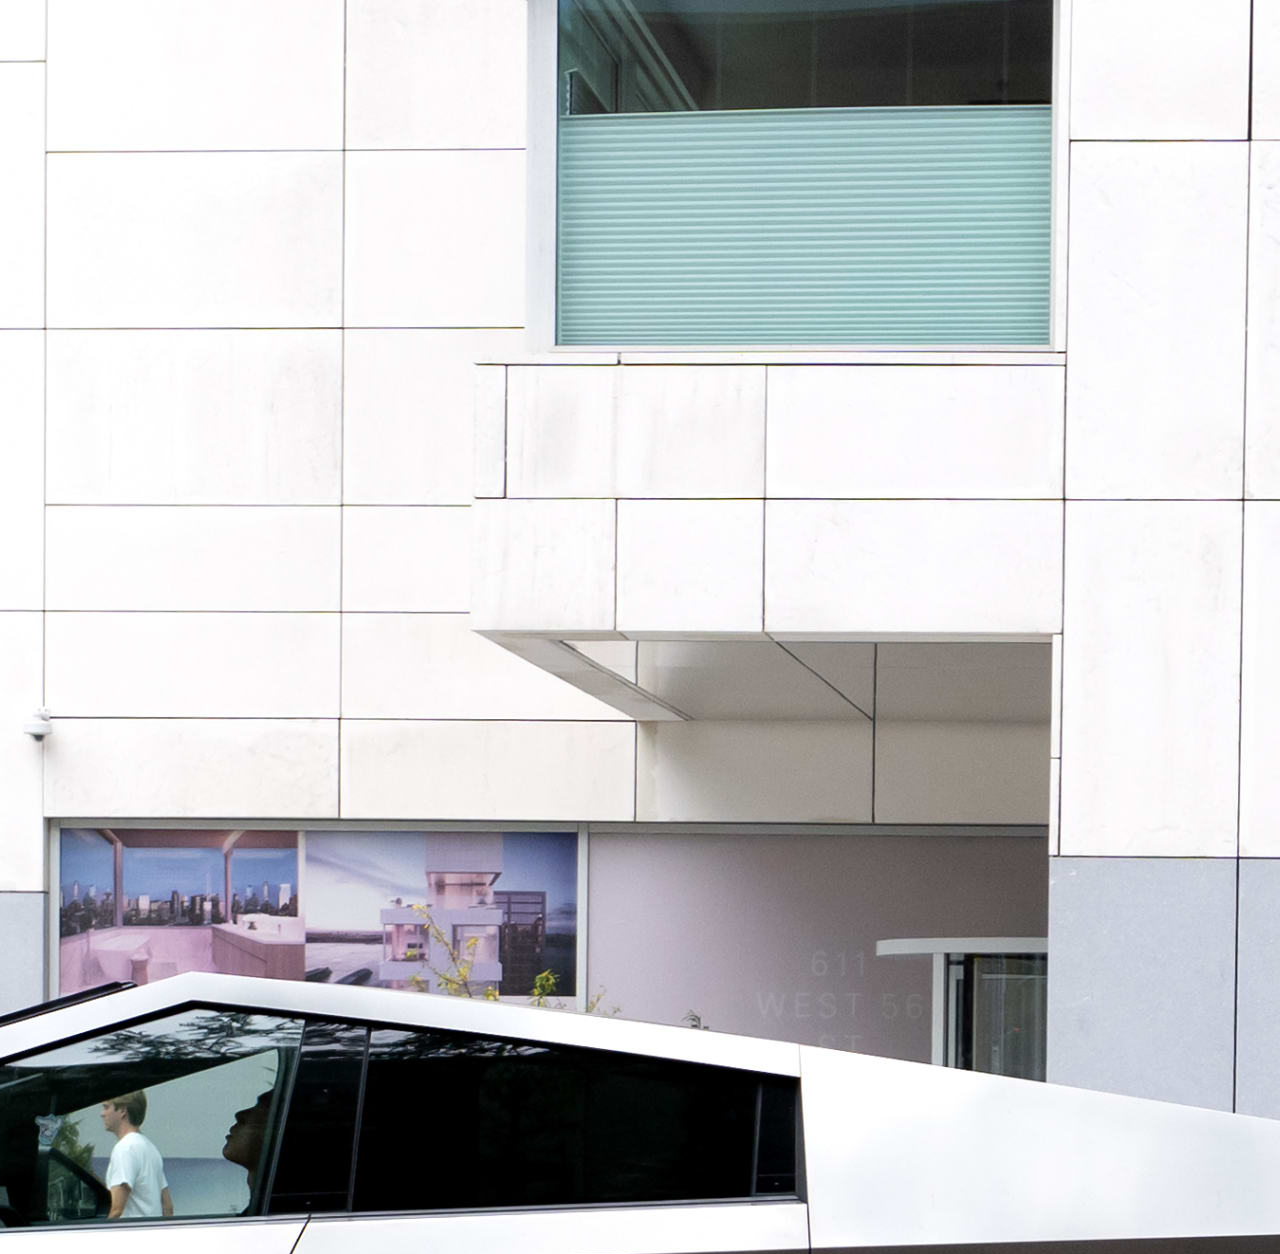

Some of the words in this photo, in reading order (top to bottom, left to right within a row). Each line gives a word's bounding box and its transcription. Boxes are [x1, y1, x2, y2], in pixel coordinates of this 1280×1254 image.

[811, 949, 864, 977] 611
[755, 992, 862, 1018] WEST
[881, 992, 923, 1019] 56
